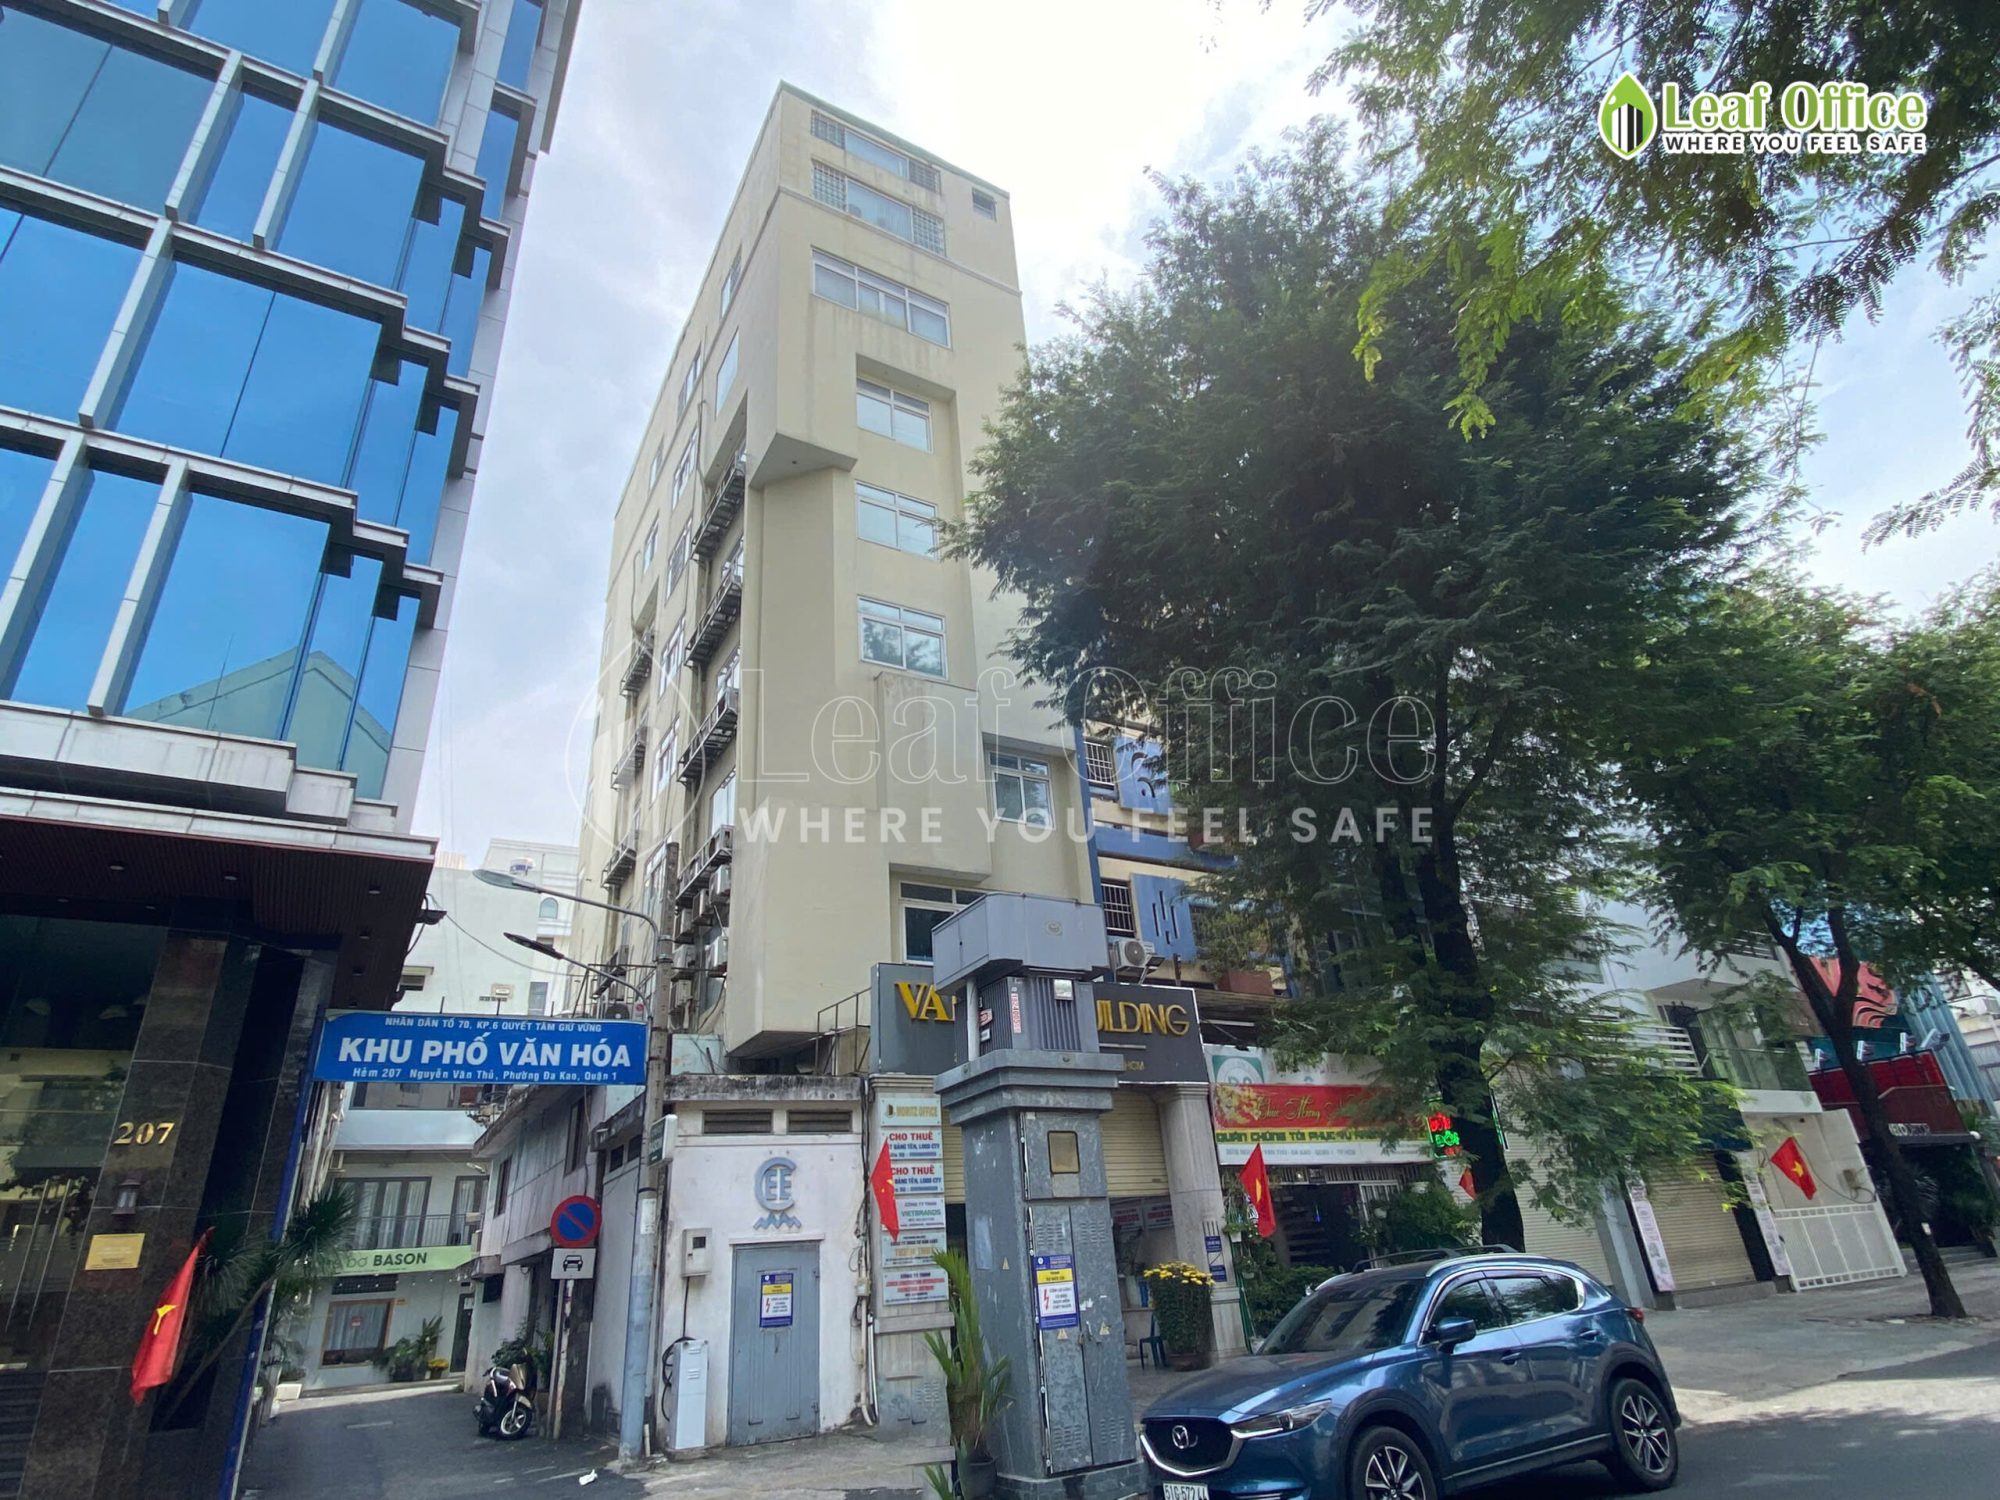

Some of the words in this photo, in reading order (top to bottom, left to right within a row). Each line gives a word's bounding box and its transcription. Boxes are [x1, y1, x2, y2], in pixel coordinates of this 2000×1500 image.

[894, 982, 957, 1021] VA
[385, 1017, 414, 1027] NHÂN
[418, 1017, 438, 1028] DÂN
[338, 1037, 413, 1064] KHU
[421, 1032, 491, 1066] PHỐ
[499, 1037, 562, 1067] VĂN
[570, 1038, 631, 1067] HÓA
[382, 1068, 402, 1078] 207
[409, 1067, 448, 1080] Nguyễn
[453, 1069, 472, 1079] Văn
[503, 1070, 539, 1082] Phường
[543, 1070, 555, 1080] Đa
[584, 1071, 609, 1081] Quận
[612, 1072, 617, 1080] 1
[113, 1121, 175, 1145] 207
[889, 1132, 908, 1141] CHO
[910, 1130, 933, 1141] THUÊ
[891, 1167, 909, 1175] CHO
[911, 1165, 935, 1175] THUÊ
[373, 1253, 427, 1267] BASON
